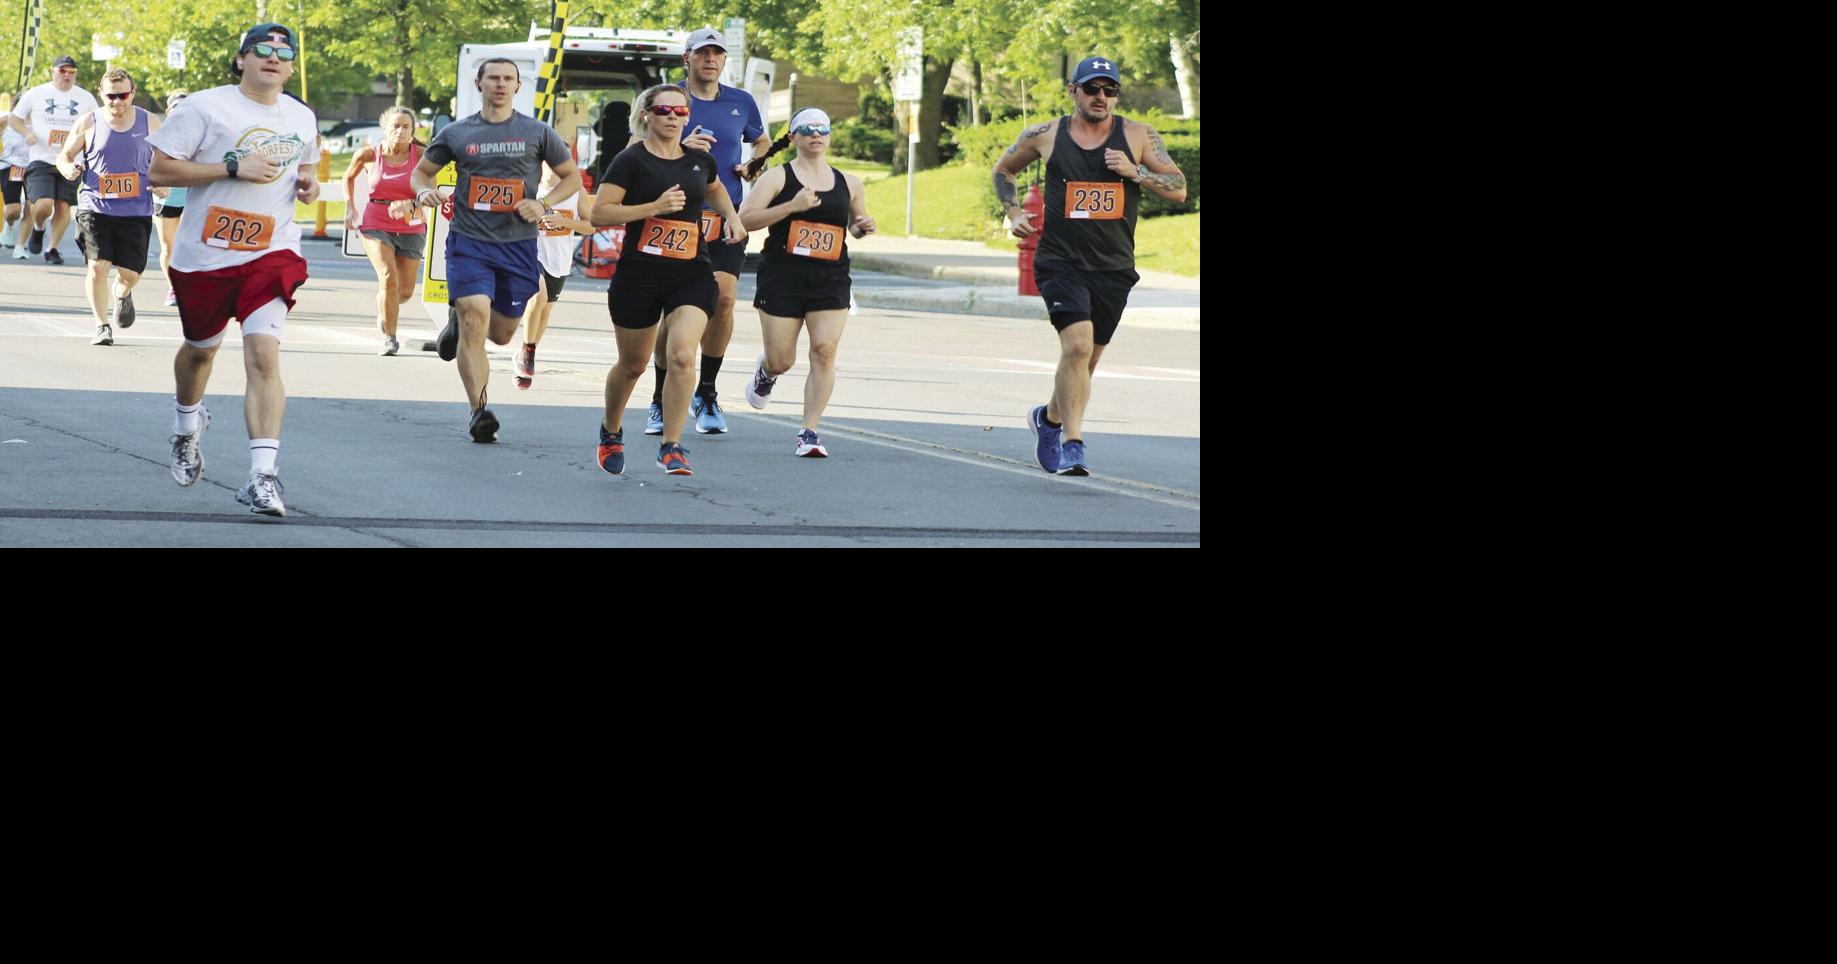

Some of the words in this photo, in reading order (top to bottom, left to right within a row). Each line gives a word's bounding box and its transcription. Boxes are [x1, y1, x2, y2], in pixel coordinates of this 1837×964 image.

[480, 141, 526, 154] SPARTAN
[104, 178, 132, 194] 216
[477, 184, 514, 206] 225
[1074, 189, 1115, 212] 235
[213, 215, 262, 246] 262
[647, 226, 689, 251] 242
[796, 228, 834, 252] 239
